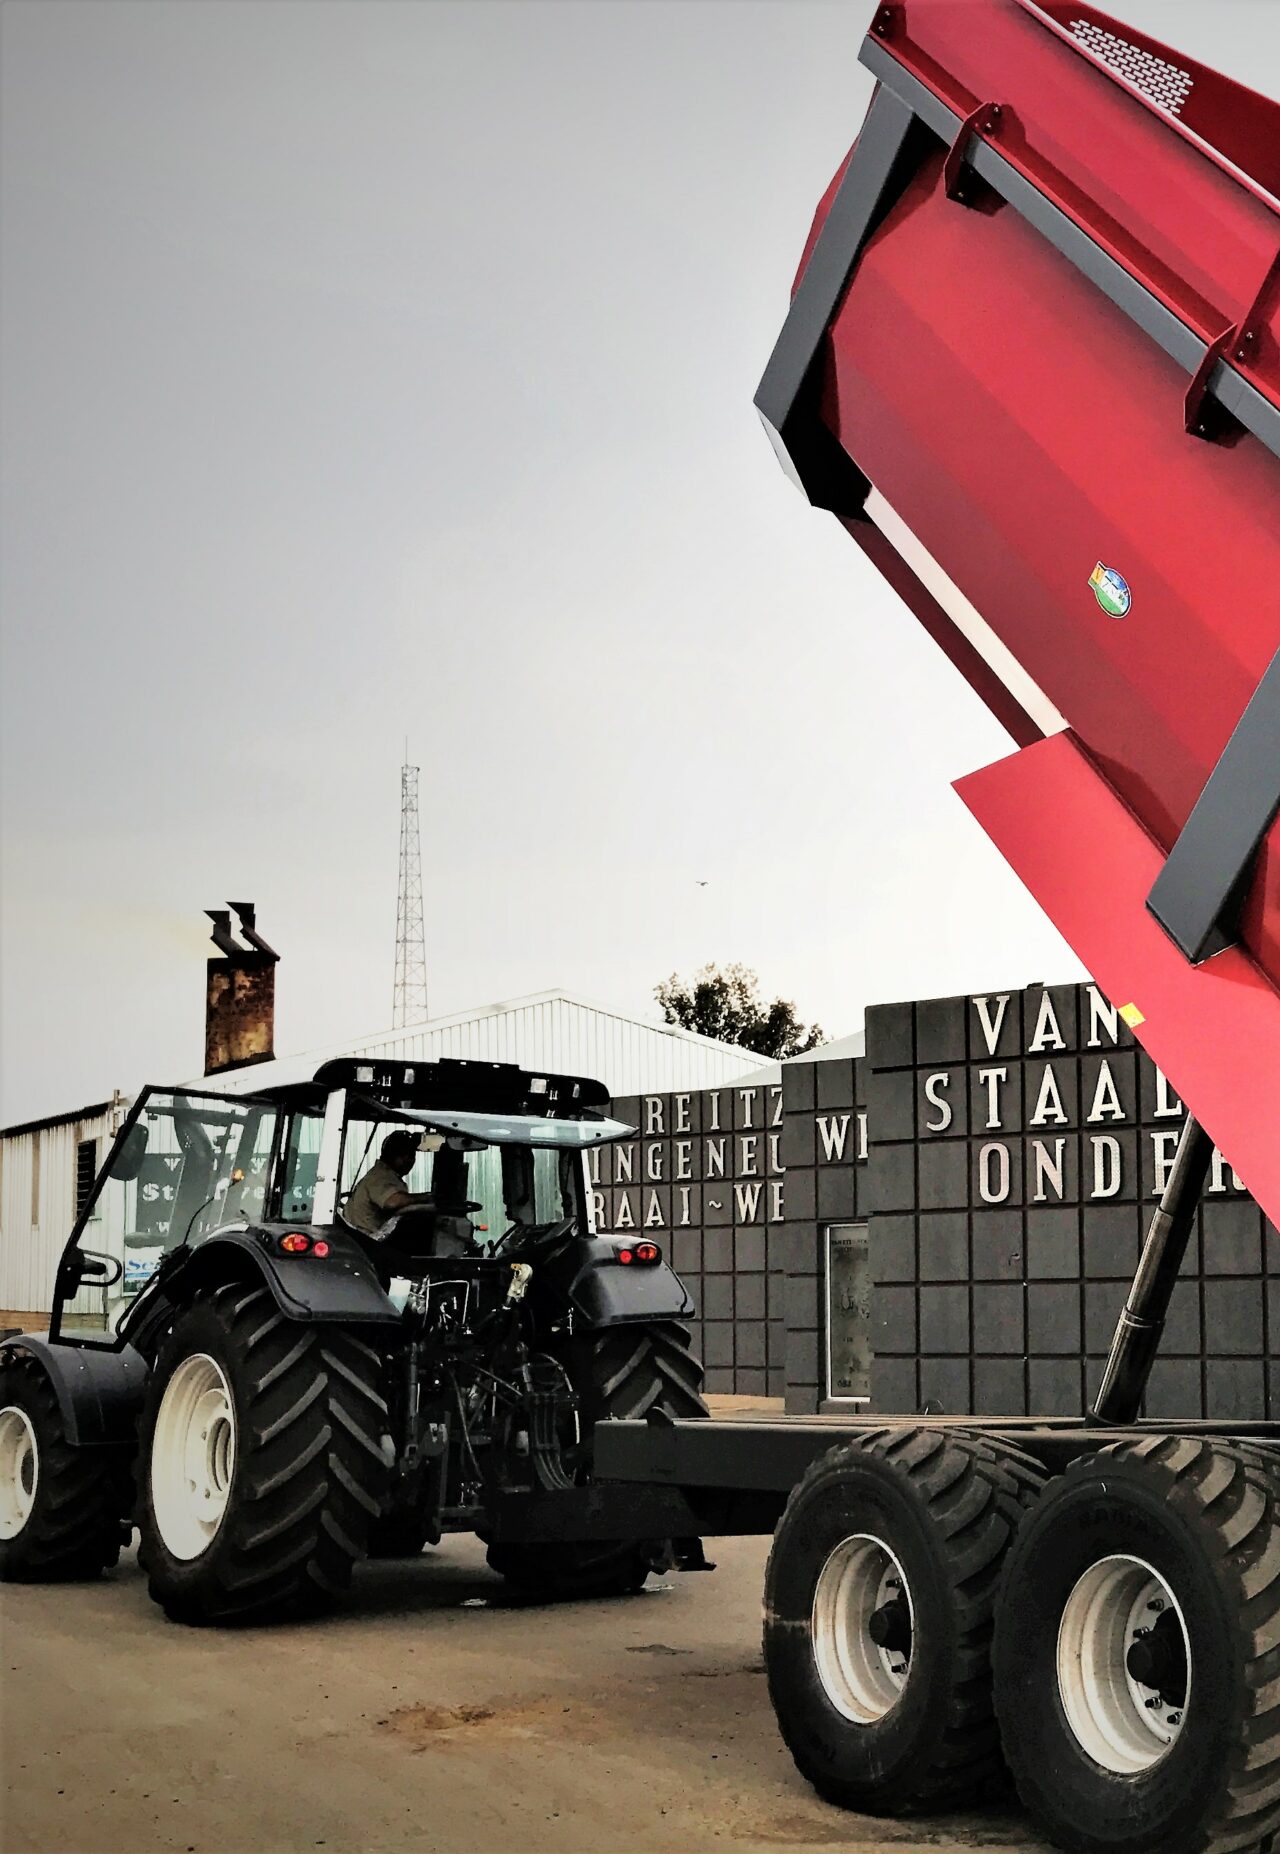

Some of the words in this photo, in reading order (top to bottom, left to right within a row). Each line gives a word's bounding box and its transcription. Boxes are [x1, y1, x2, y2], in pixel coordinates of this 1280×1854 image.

[973, 986, 1118, 1056] VAN
[645, 1086, 783, 1135] REITZ
[925, 1060, 1182, 1132] STAAL
